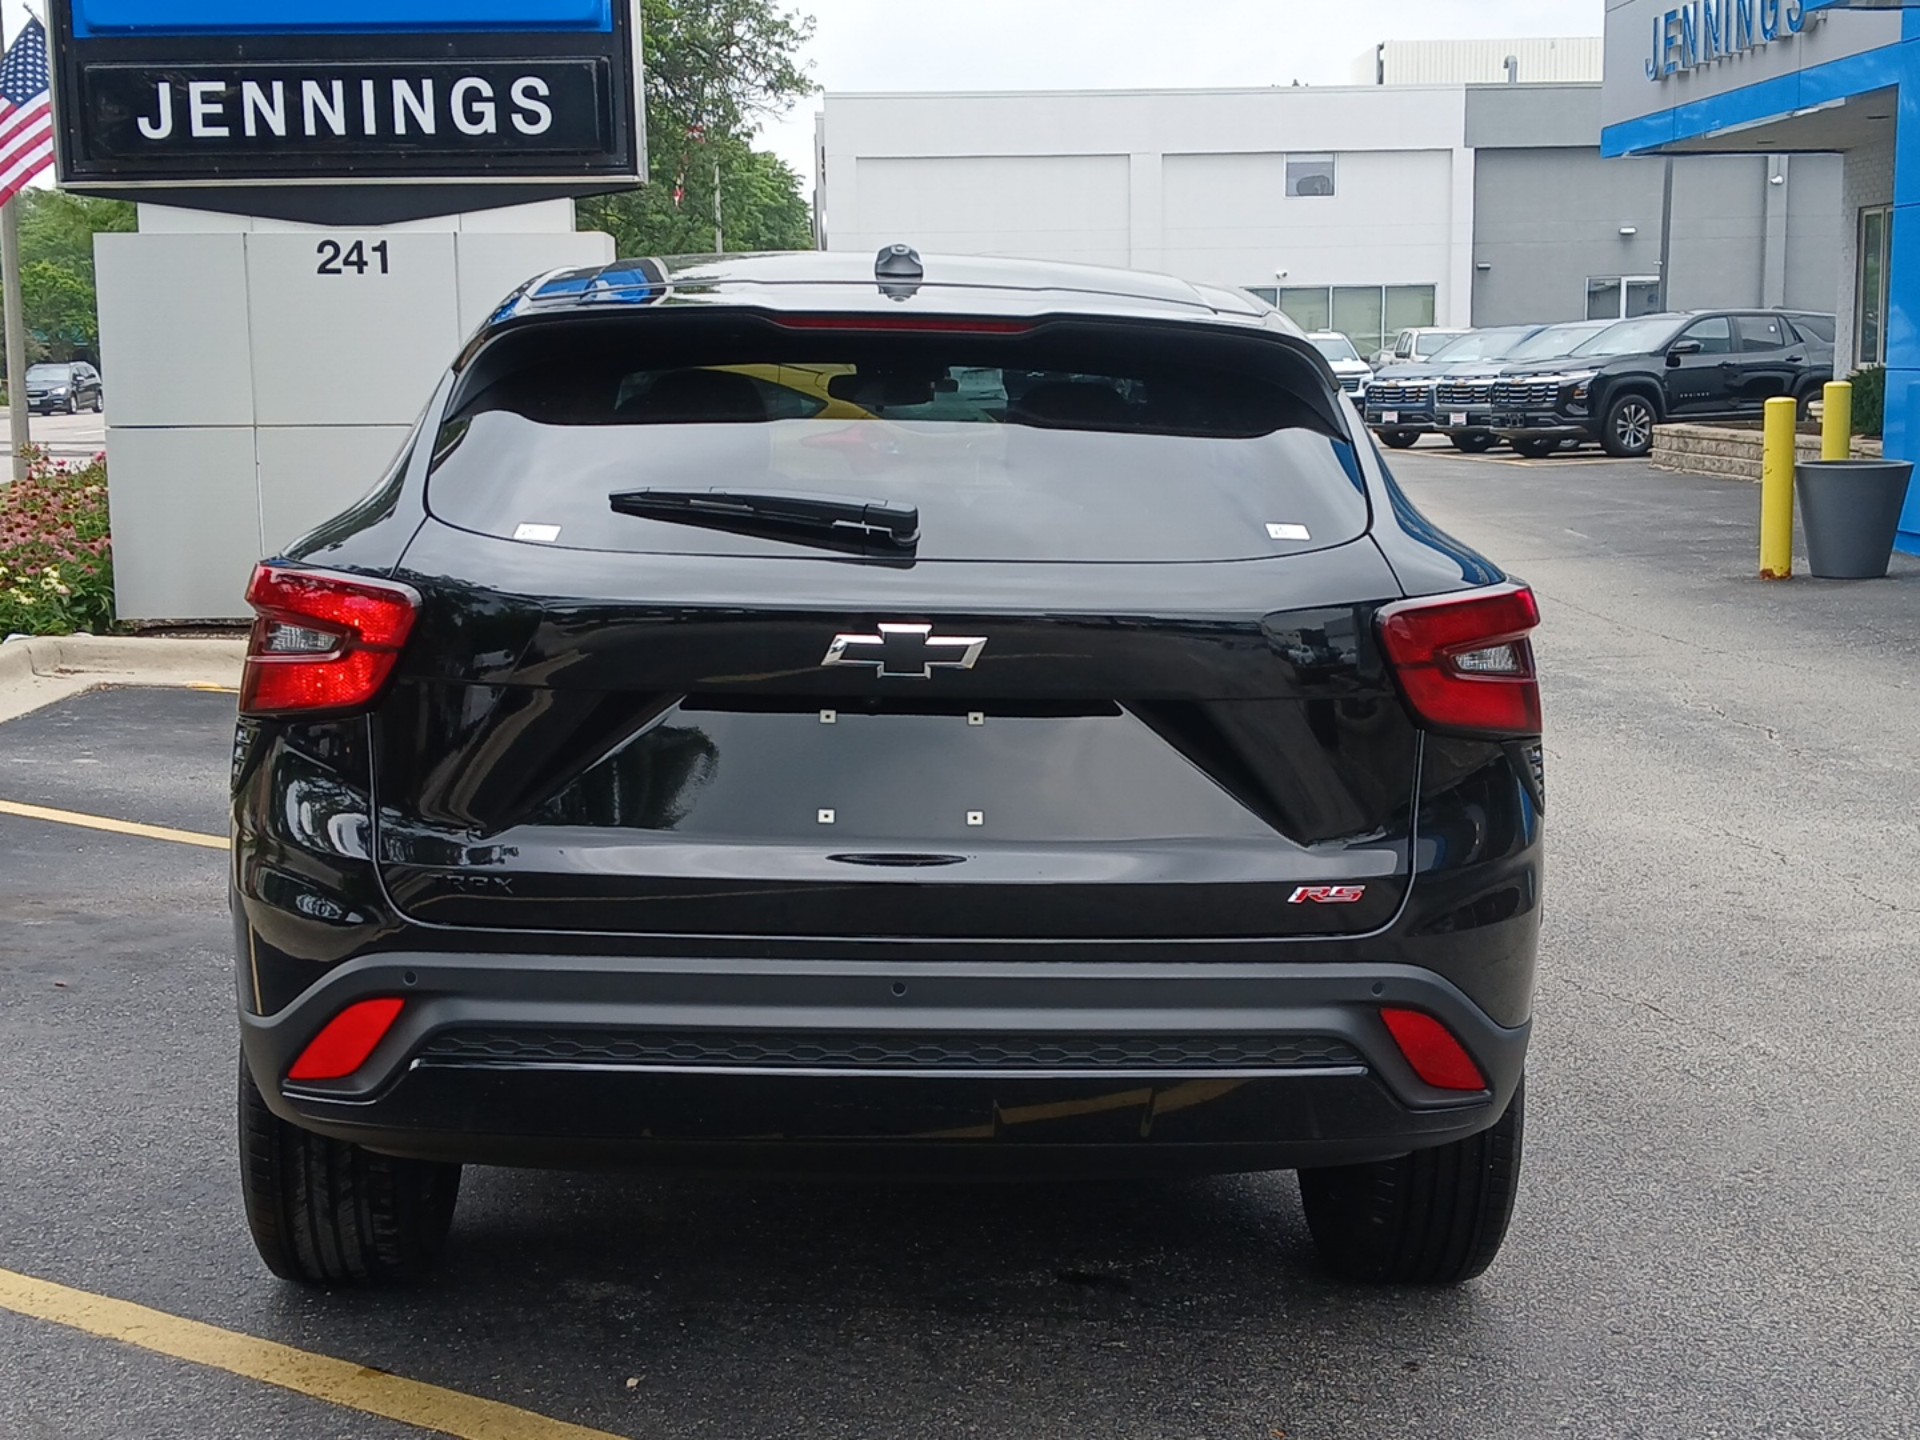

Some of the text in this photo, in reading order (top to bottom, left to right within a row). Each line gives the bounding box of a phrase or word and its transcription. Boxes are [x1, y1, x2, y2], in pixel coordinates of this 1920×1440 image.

[137, 76, 552, 140] JENNINGS
[316, 239, 388, 275] 241
[1287, 885, 1366, 903] RS
